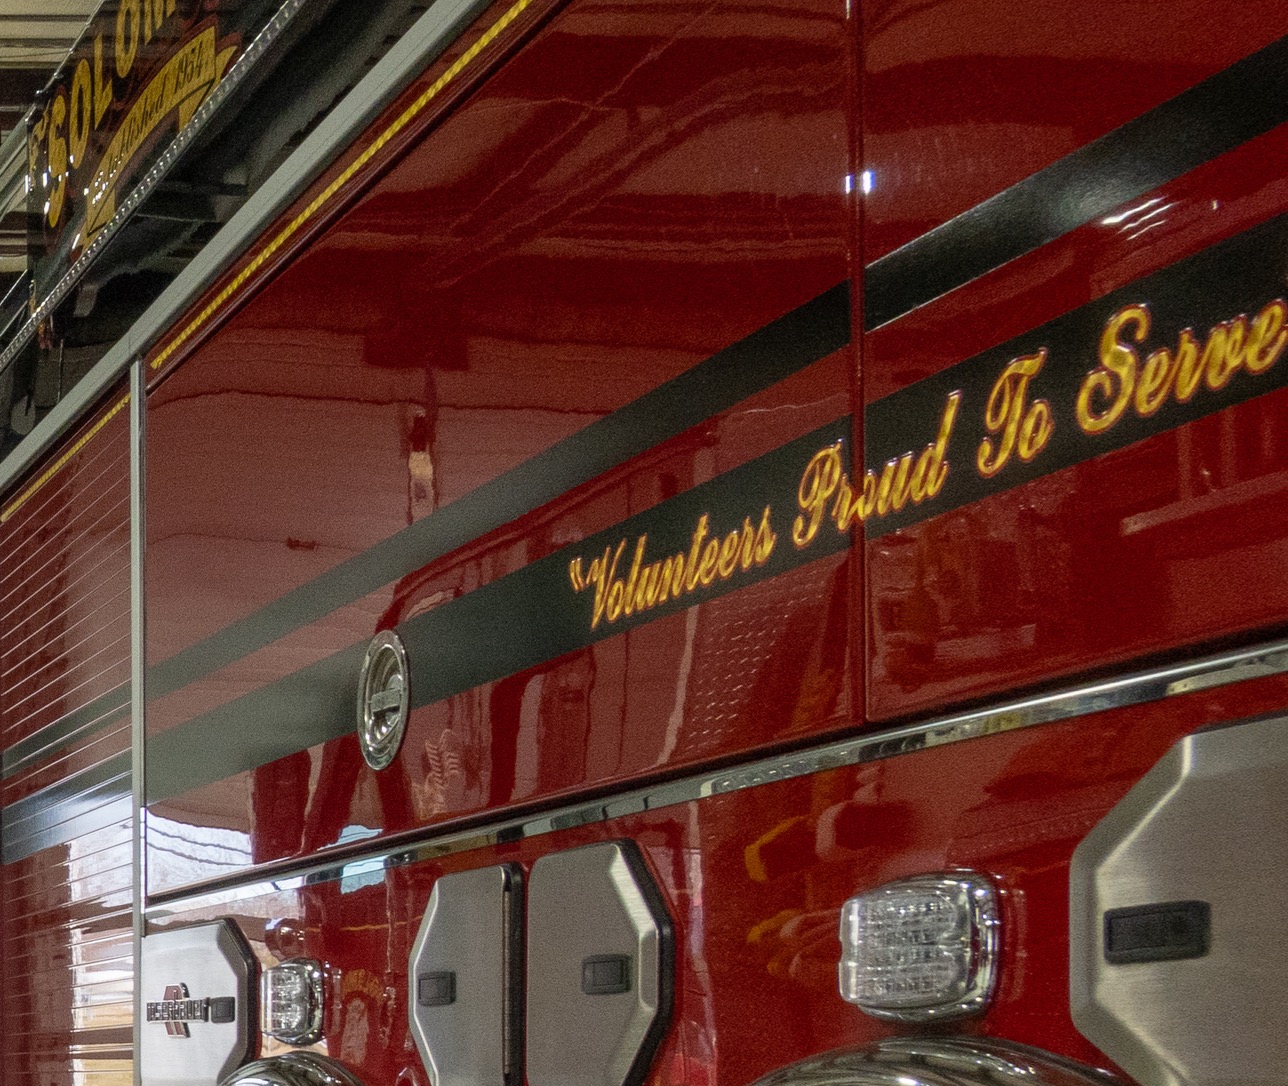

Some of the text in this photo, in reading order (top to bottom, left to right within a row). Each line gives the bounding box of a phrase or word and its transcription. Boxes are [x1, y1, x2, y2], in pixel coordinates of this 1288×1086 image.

[176, 40, 204, 90] 1954
[793, 389, 962, 549] Proud
[977, 347, 1054, 478] To
[1076, 299, 1288, 435] Serve
